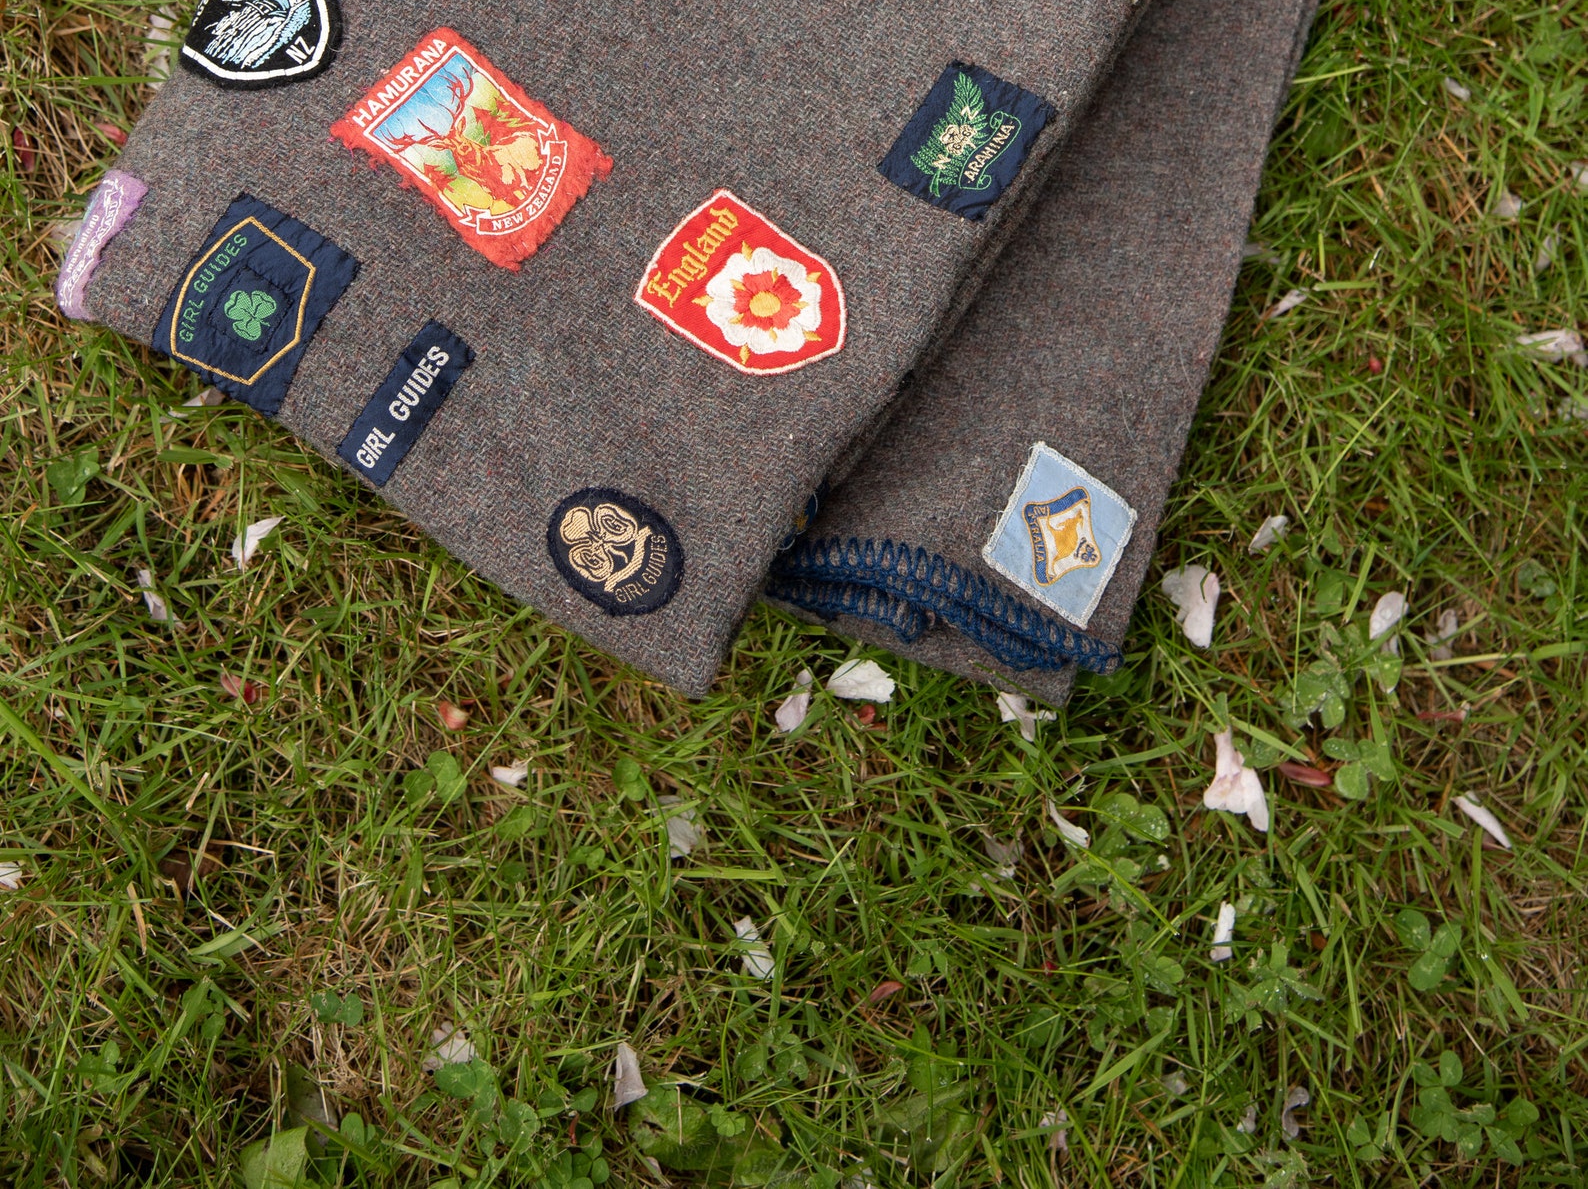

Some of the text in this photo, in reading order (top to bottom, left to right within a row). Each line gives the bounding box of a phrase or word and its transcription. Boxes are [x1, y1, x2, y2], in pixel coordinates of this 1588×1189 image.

[285, 35, 316, 65] NZ
[352, 37, 448, 128] HAMURANA
[491, 154, 562, 232] NEW ZEALAND
[963, 123, 1016, 183] ARAHINA
[178, 233, 248, 343] GIRL GUIDES
[647, 206, 739, 308] England
[356, 345, 450, 469] GIRL GUIDES
[614, 534, 668, 603] GIRL GUIDES
